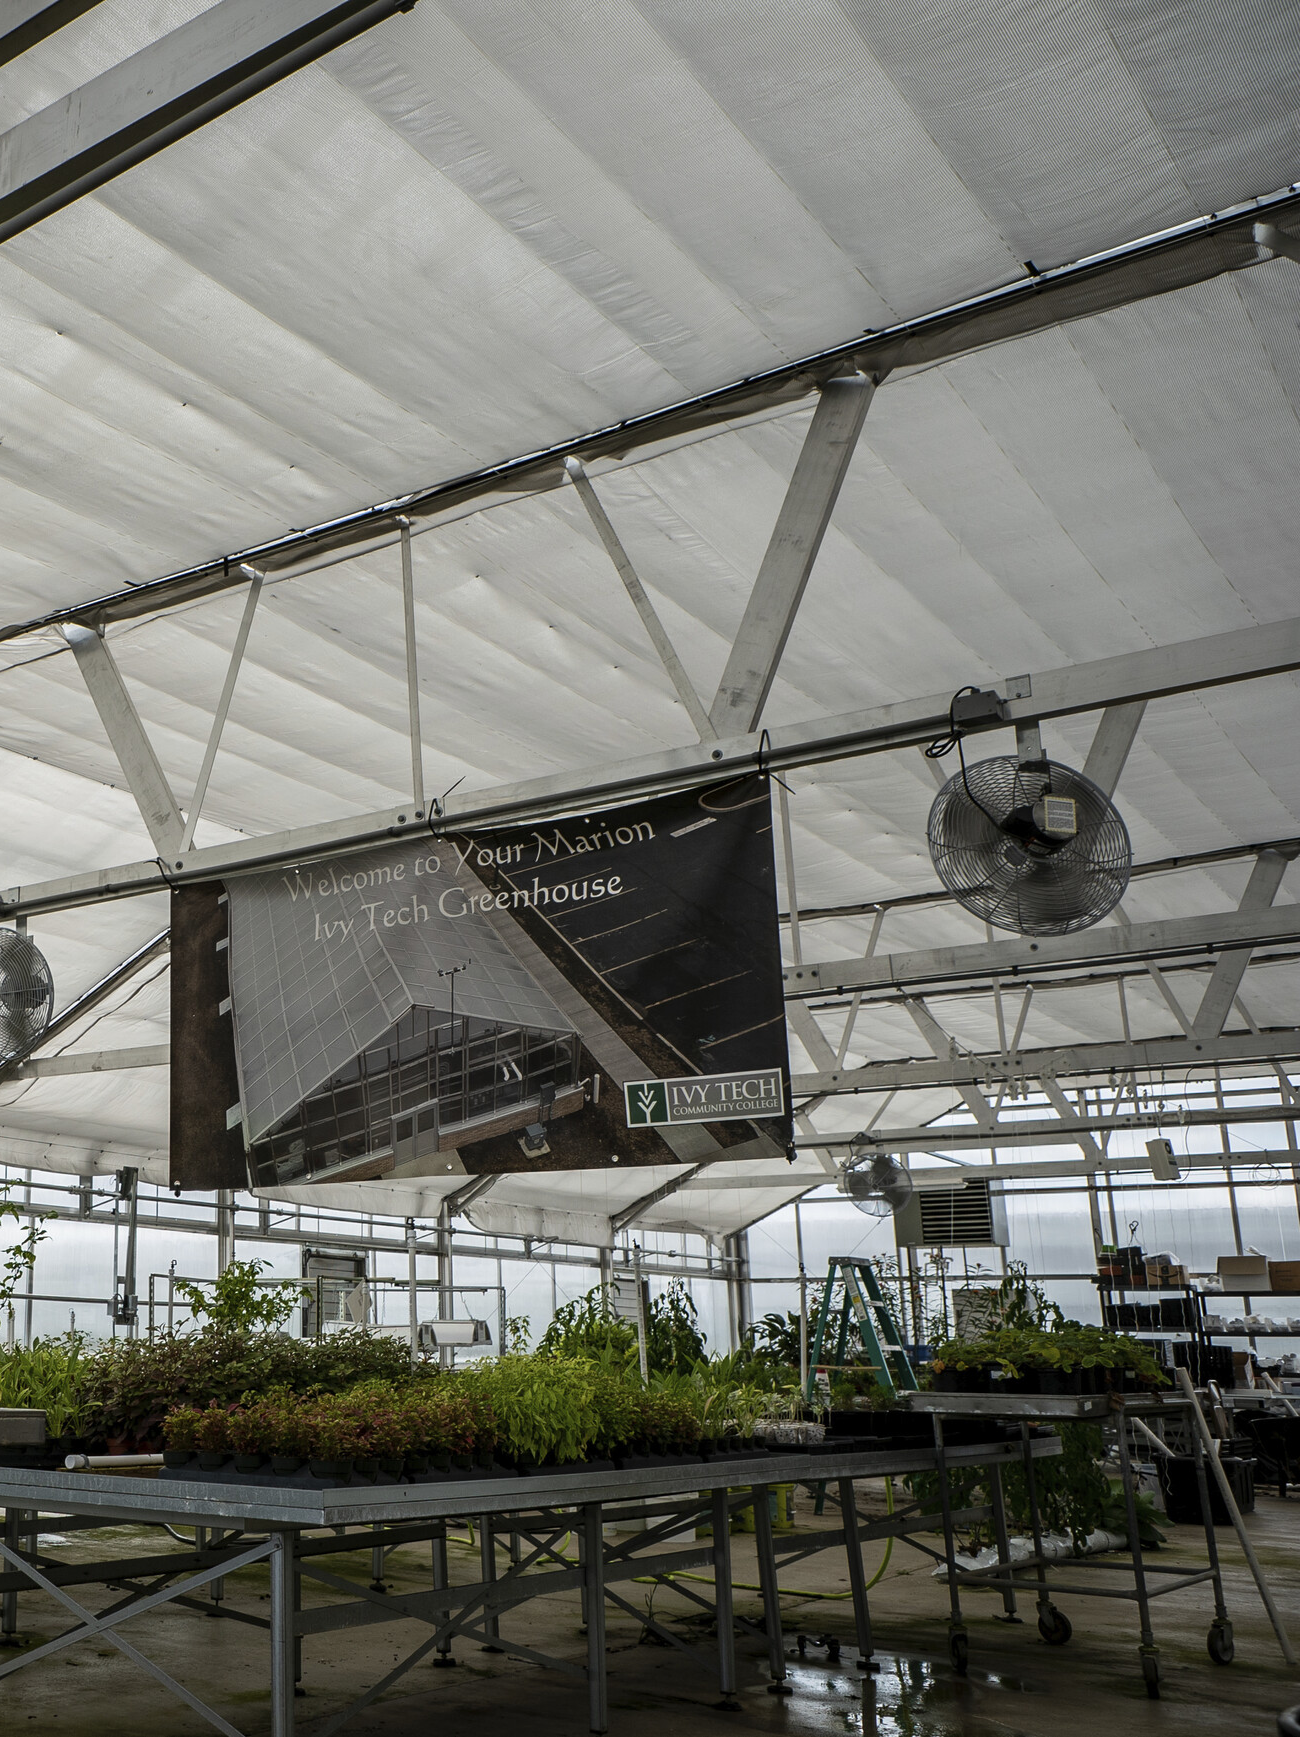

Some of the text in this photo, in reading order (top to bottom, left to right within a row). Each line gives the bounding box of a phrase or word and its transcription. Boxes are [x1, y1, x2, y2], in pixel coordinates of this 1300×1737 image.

[283, 820, 655, 902] Welcome to Your Marion
[314, 875, 623, 943] Ivy Tech Greenhouse
[672, 1077, 778, 1105] IVY TECH
[673, 1099, 779, 1116] COMMUNITY COLLEGE
